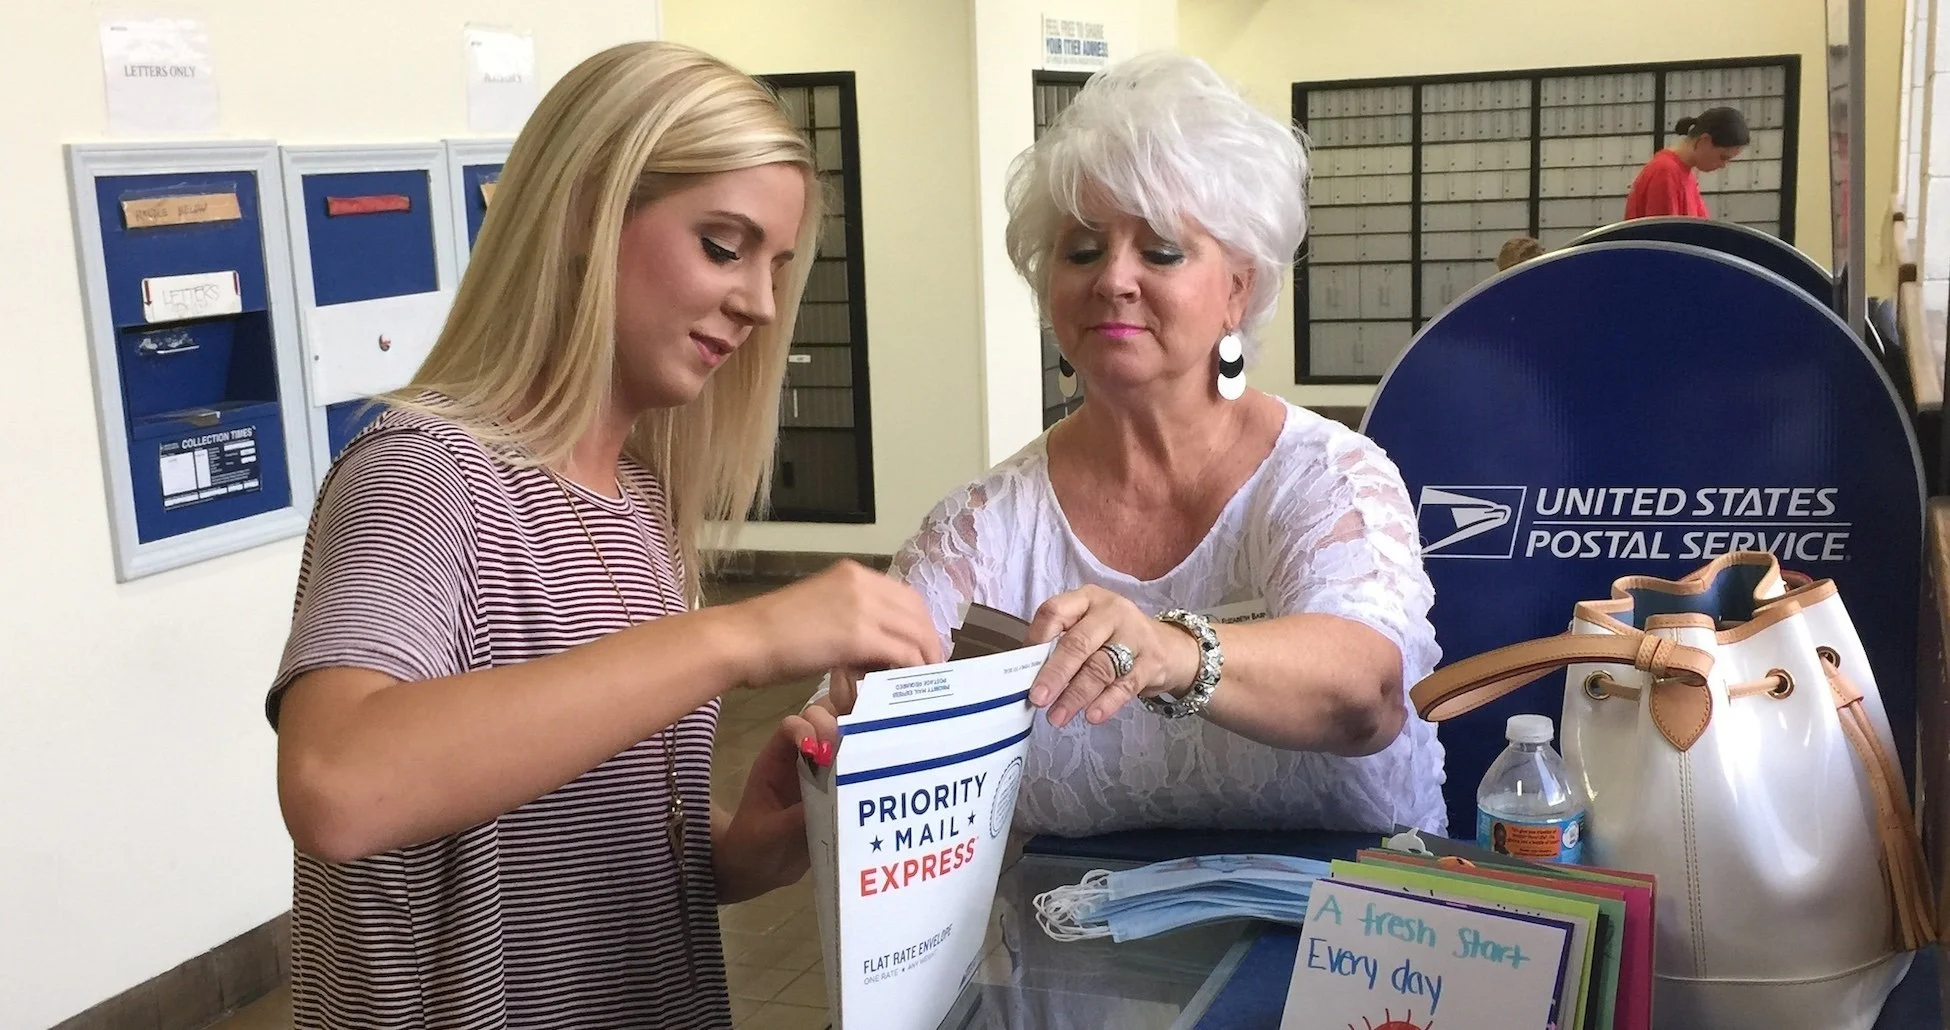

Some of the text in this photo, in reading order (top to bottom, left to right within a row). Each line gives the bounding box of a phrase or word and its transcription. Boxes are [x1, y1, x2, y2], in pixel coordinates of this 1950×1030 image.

[1046, 37, 1062, 54] YOUR
[124, 65, 196, 78] LETTERS ONLY
[162, 283, 220, 305] LETTERS
[181, 432, 230, 449] COLLECTION
[230, 427, 253, 439] TIMES
[1535, 487, 1839, 517] UNITED STATES
[1525, 531, 1850, 561] POSTAL SERVICE
[858, 772, 988, 827] PRIORITY
[895, 816, 960, 852] MAIL
[860, 837, 976, 897] EXPRESS
[1314, 894, 1342, 925] A
[1358, 902, 1437, 947] fresh
[863, 922, 954, 974] FLAT RATE ENVELOPE
[863, 974, 880, 985] ONE
[881, 968, 899, 981] RATE
[1308, 937, 1443, 1016] Every day
